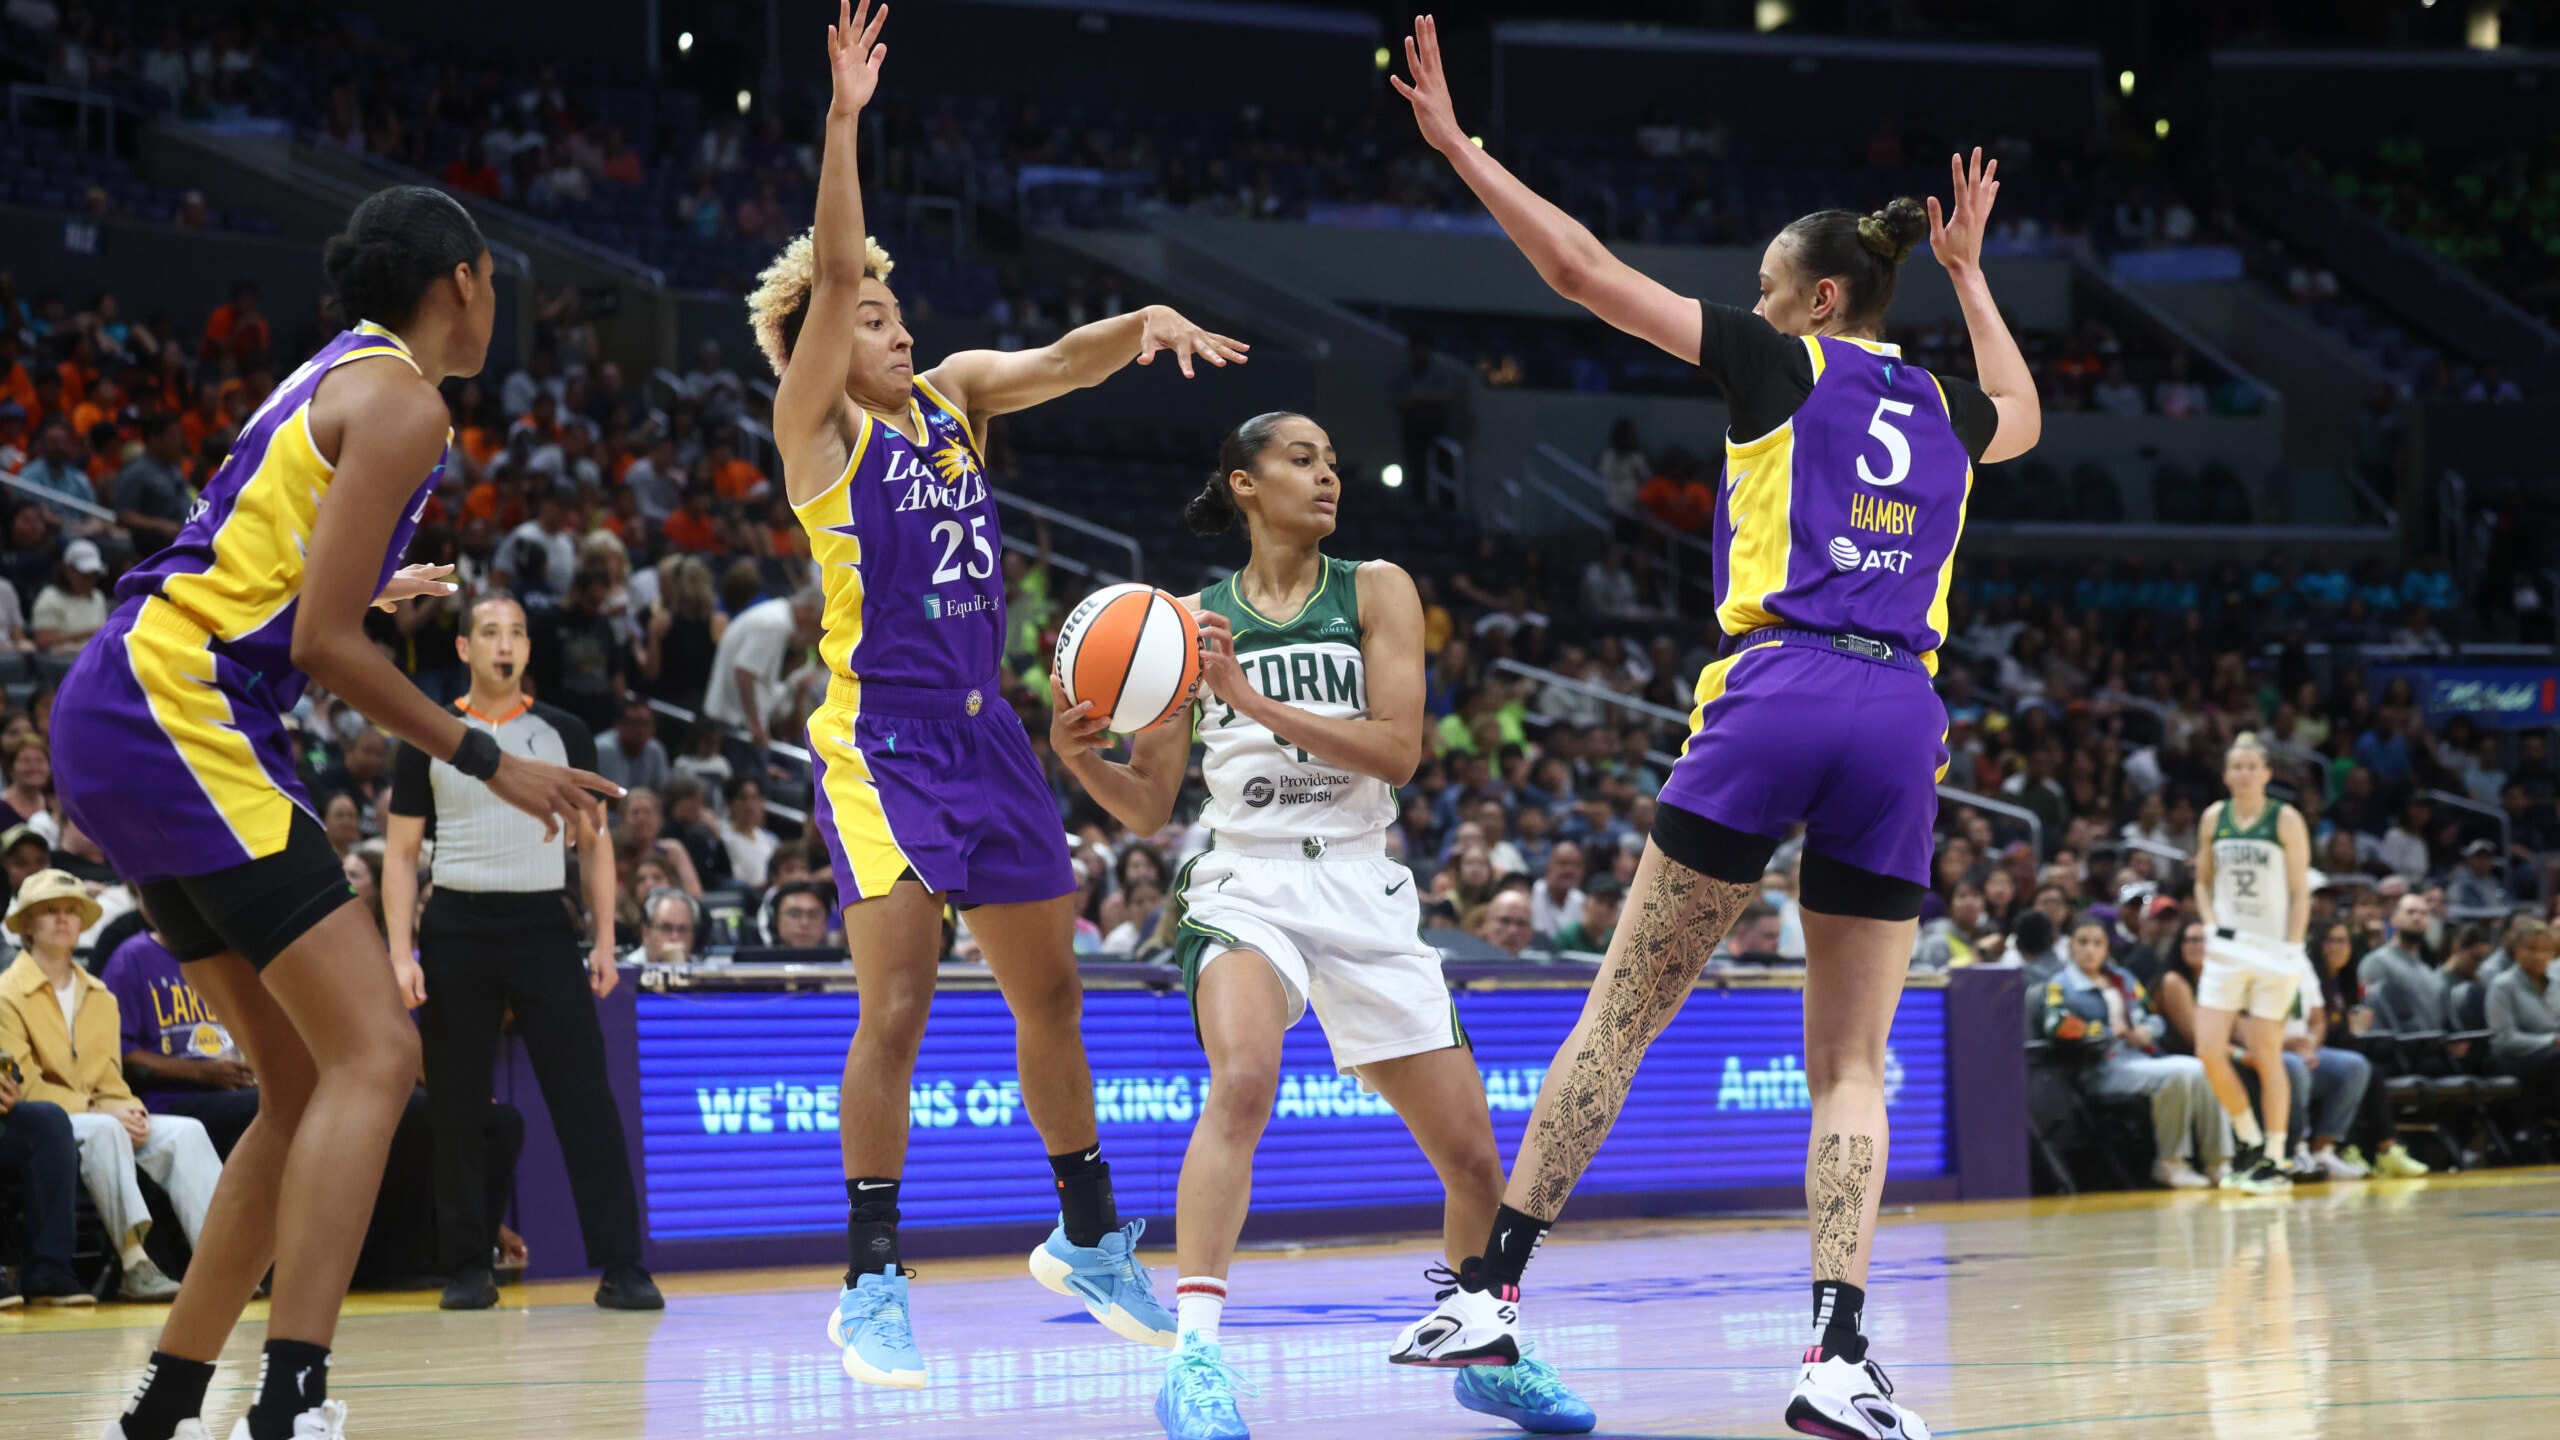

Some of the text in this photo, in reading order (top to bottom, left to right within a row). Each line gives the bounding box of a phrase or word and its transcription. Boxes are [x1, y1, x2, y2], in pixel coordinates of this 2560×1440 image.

[1856, 397, 1914, 486] 5
[1850, 493, 1917, 536] HAMBY
[930, 515, 994, 585] 25
[1861, 550, 1913, 574] AT&T
[1214, 652, 1361, 728] ORM
[1279, 773, 1350, 789] Providence
[1279, 791, 1332, 806] SWEDISH
[696, 1080, 840, 1134] WE'RE
[965, 1079, 1020, 1127] OF
[1094, 1075, 1194, 1123] KING
[1717, 1055, 1813, 1110] Anth
